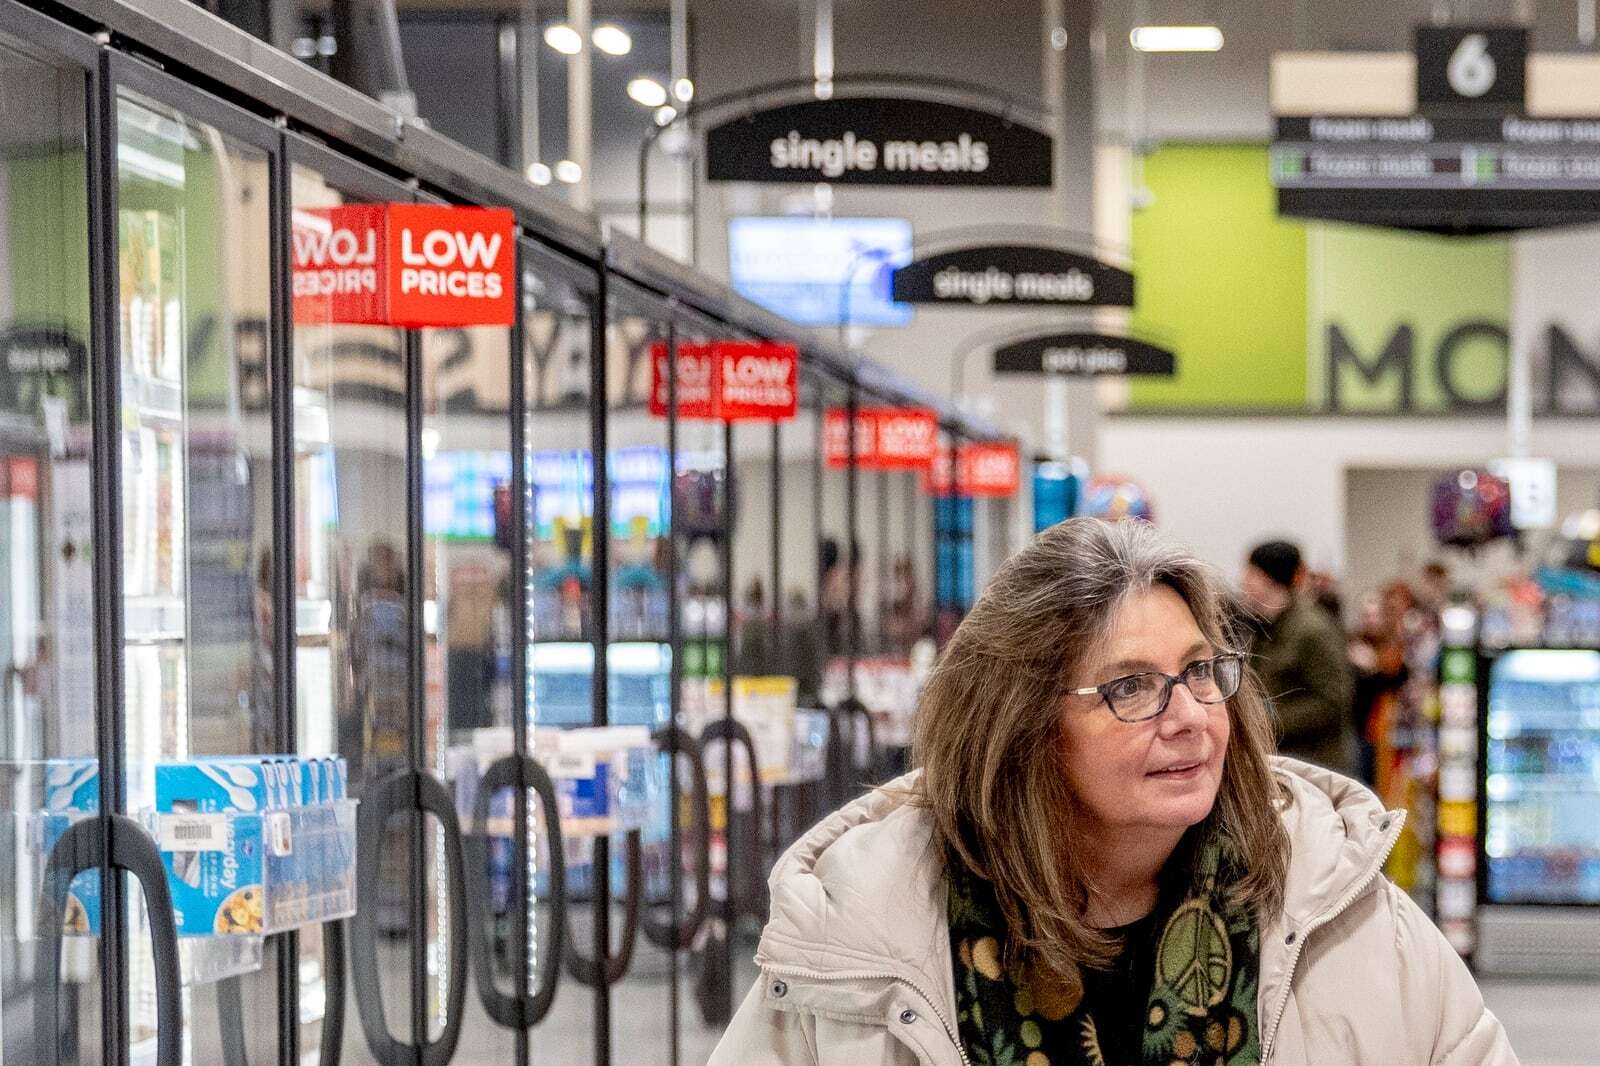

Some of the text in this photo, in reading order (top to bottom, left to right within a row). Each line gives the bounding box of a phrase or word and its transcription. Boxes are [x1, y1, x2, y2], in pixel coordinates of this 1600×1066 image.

[1447, 34, 1496, 97] 6
[770, 131, 990, 178] single meals
[402, 228, 502, 269] LOW
[402, 268, 503, 299] PRICES
[722, 355, 793, 383] LOW
